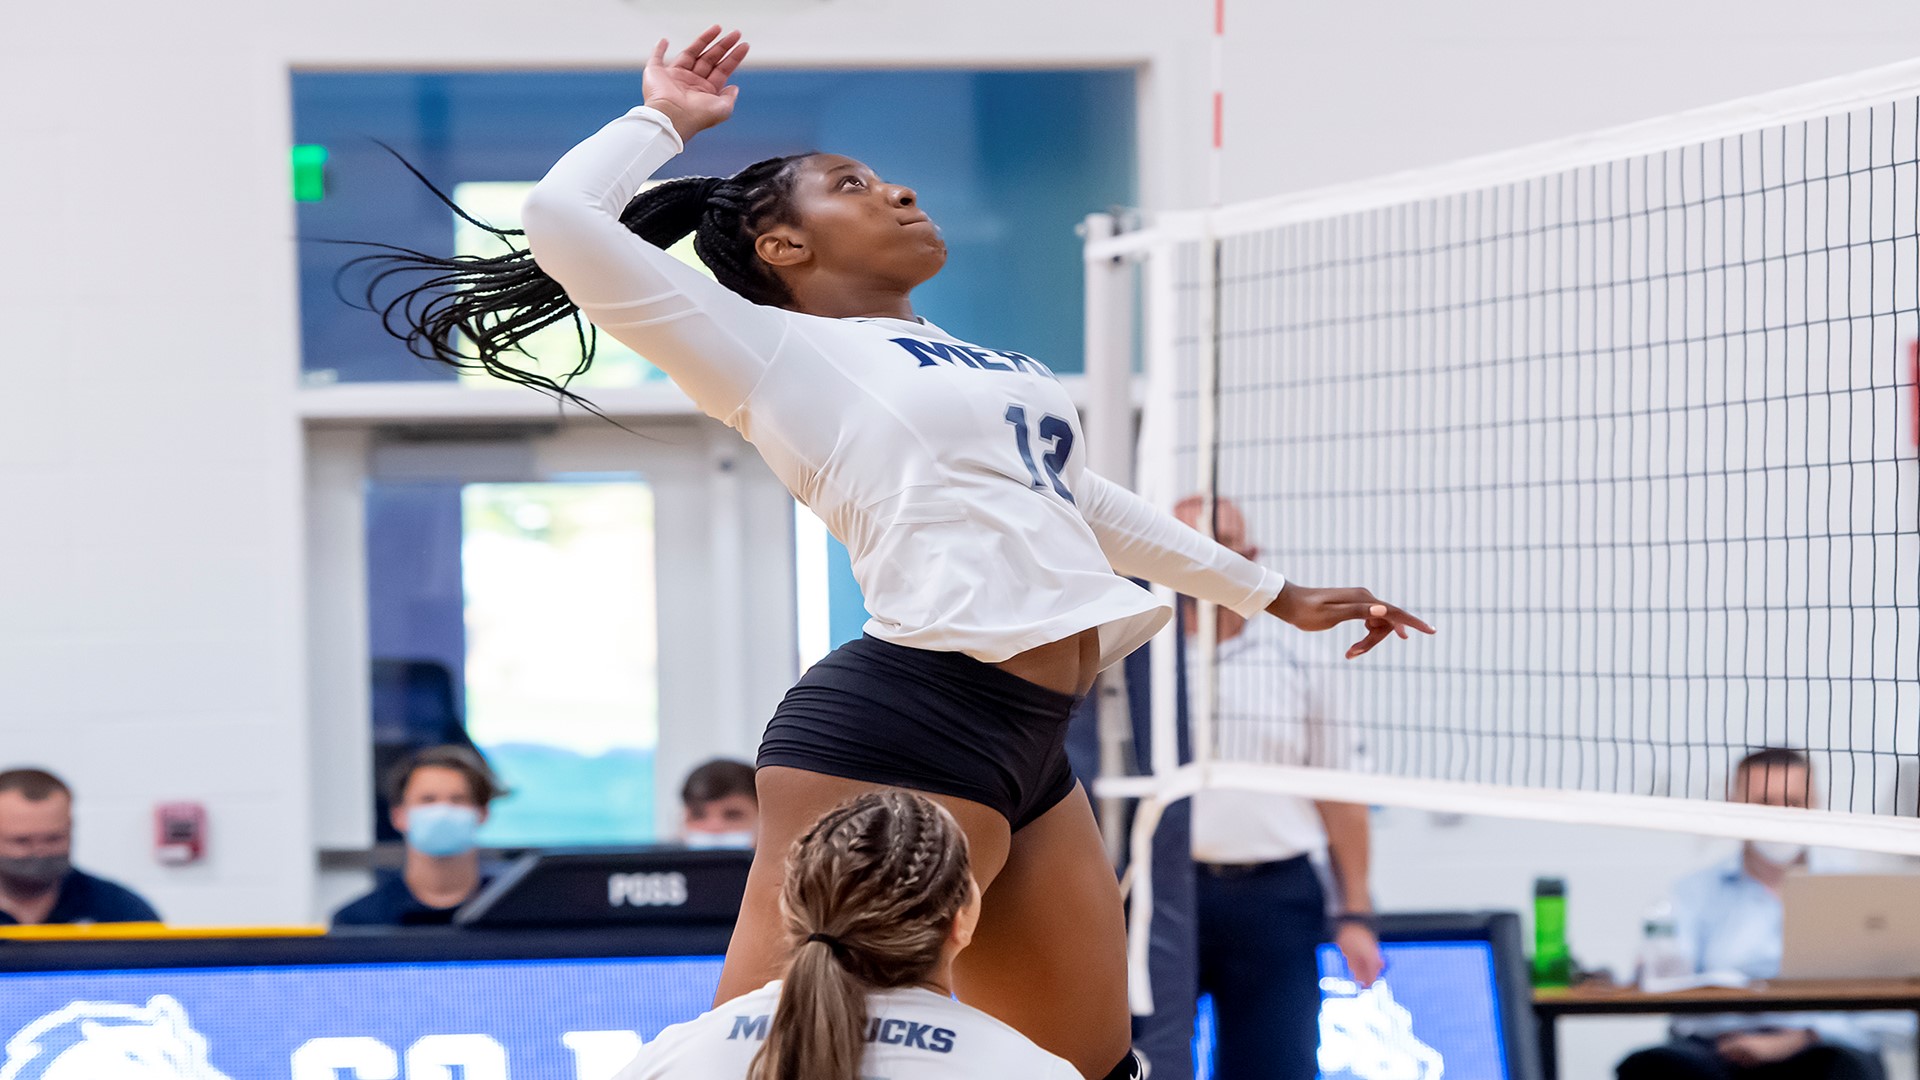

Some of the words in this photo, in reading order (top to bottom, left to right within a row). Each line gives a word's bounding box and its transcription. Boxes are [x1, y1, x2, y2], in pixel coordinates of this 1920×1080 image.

[889, 337, 1056, 380] MER
[1004, 402, 1076, 505] 12
[608, 872, 687, 906] POSS
[727, 1015, 956, 1053] MICKS
